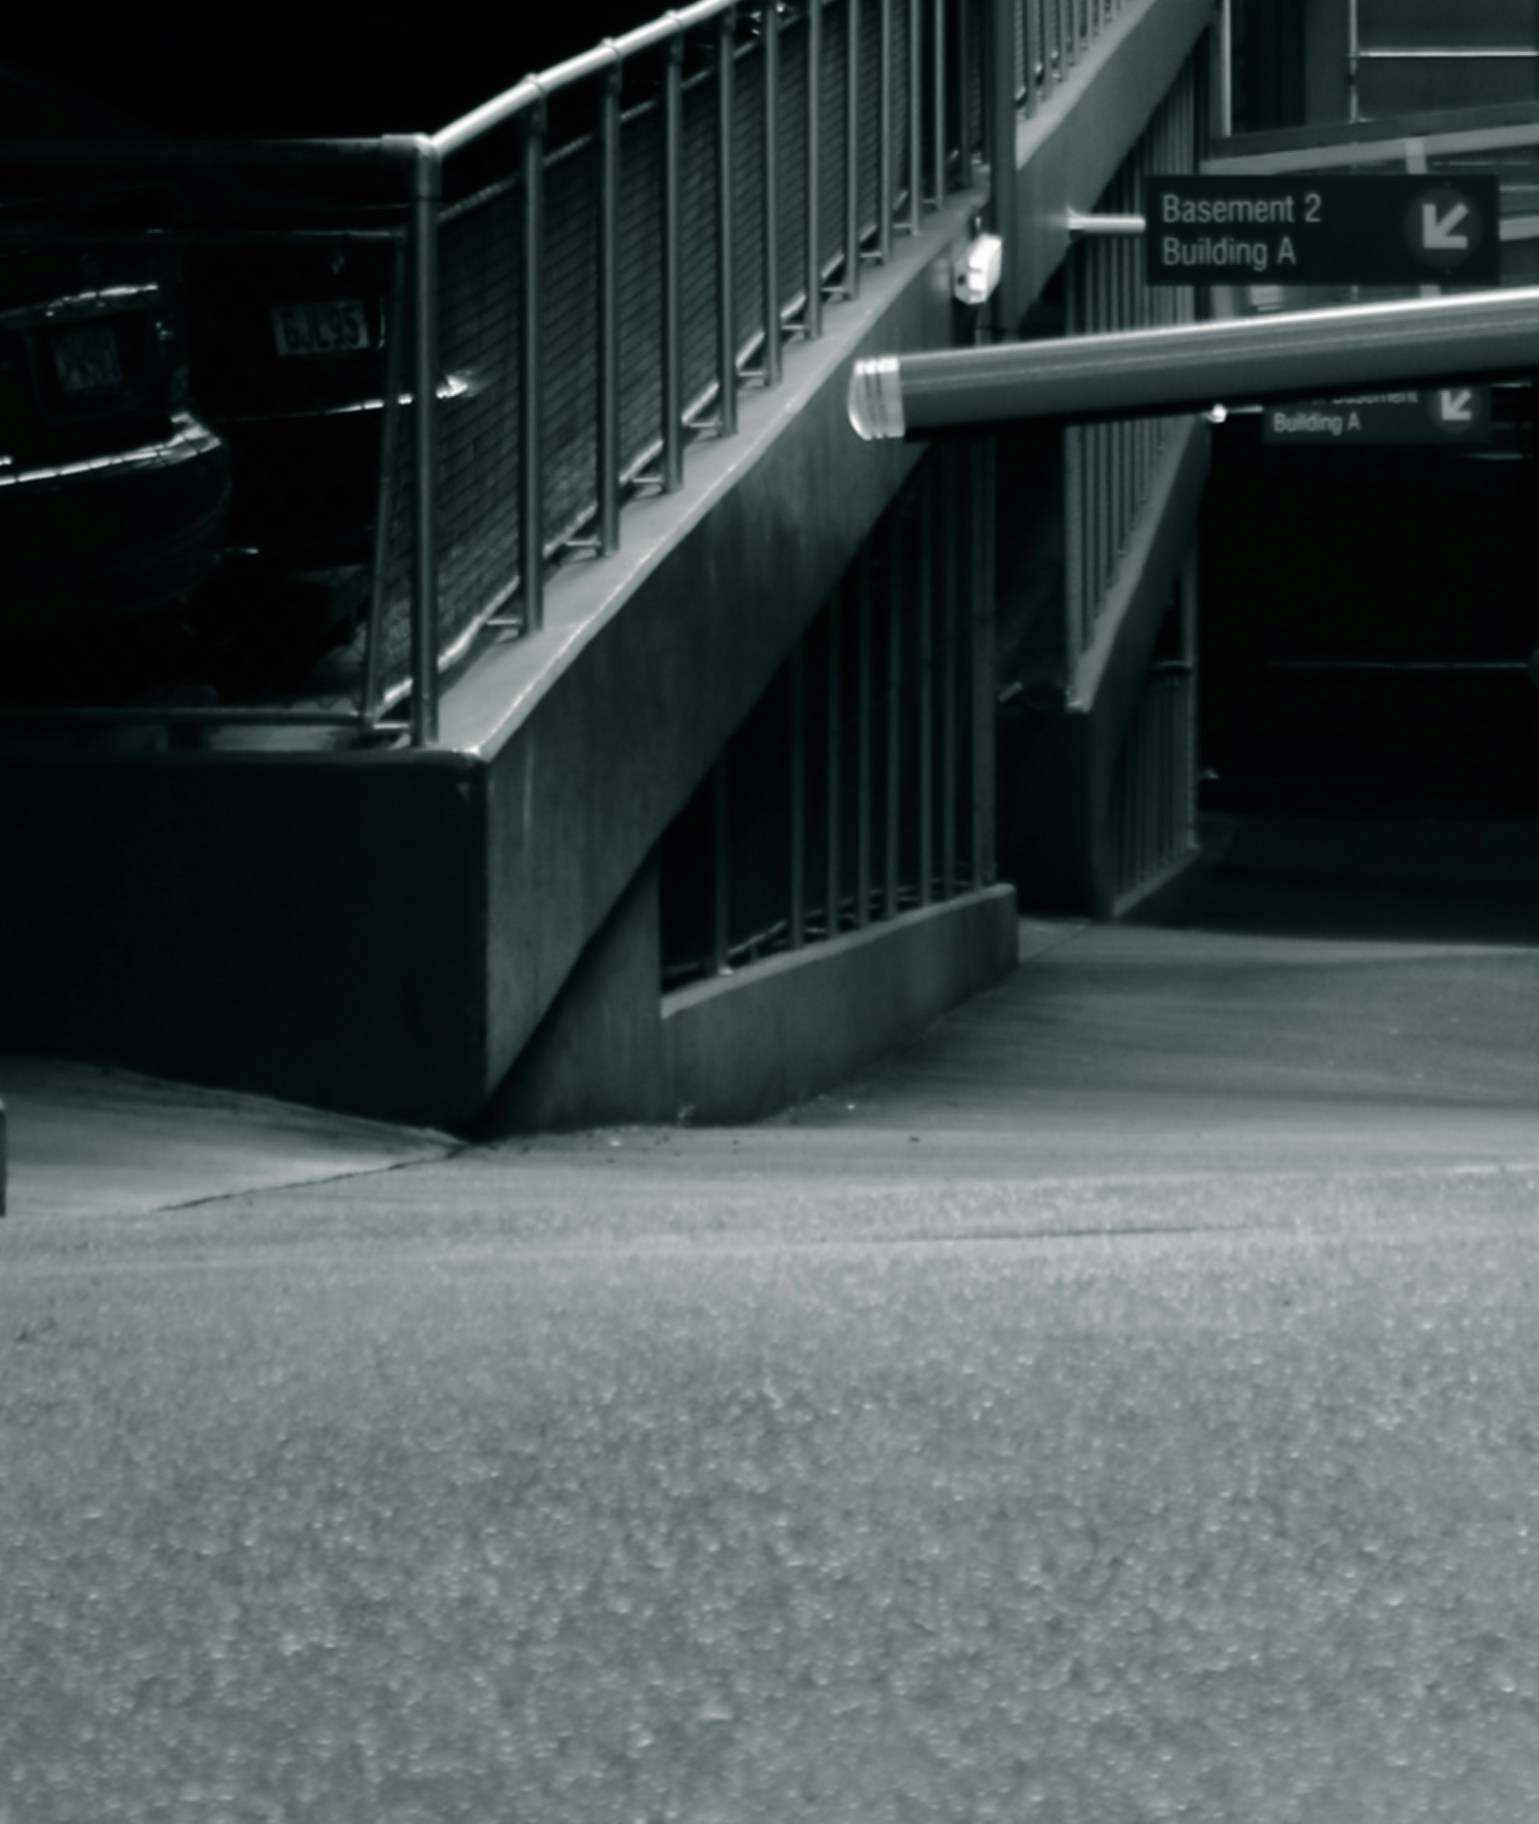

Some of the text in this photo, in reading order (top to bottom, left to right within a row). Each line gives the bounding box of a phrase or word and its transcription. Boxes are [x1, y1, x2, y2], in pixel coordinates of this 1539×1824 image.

[1162, 192, 1322, 224] Basement 2
[1162, 235, 1297, 272] Building A
[1272, 411, 1361, 436] Building A
